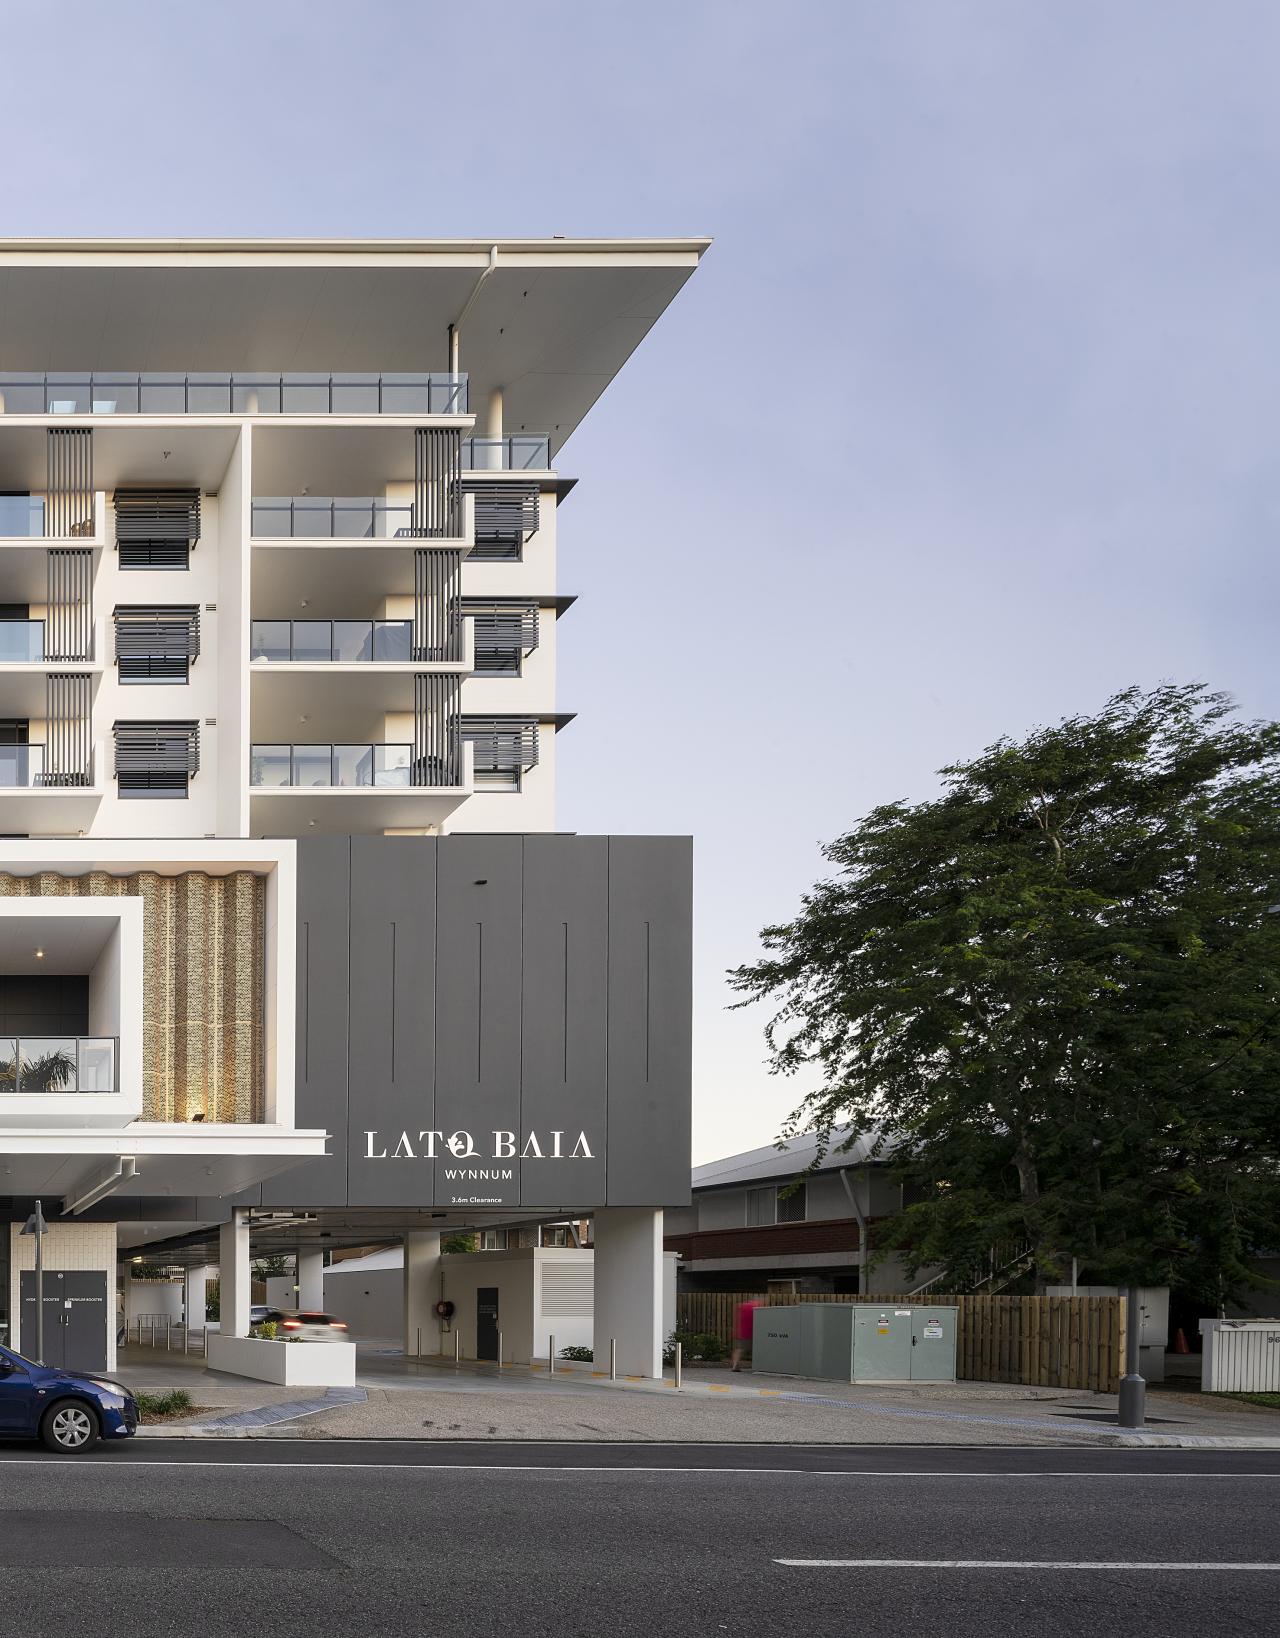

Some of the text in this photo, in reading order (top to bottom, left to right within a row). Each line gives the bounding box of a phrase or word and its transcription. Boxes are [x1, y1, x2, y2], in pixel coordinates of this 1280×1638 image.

[363, 1130, 595, 1159] LATO BAIA
[445, 1169, 513, 1180] WYNNUM
